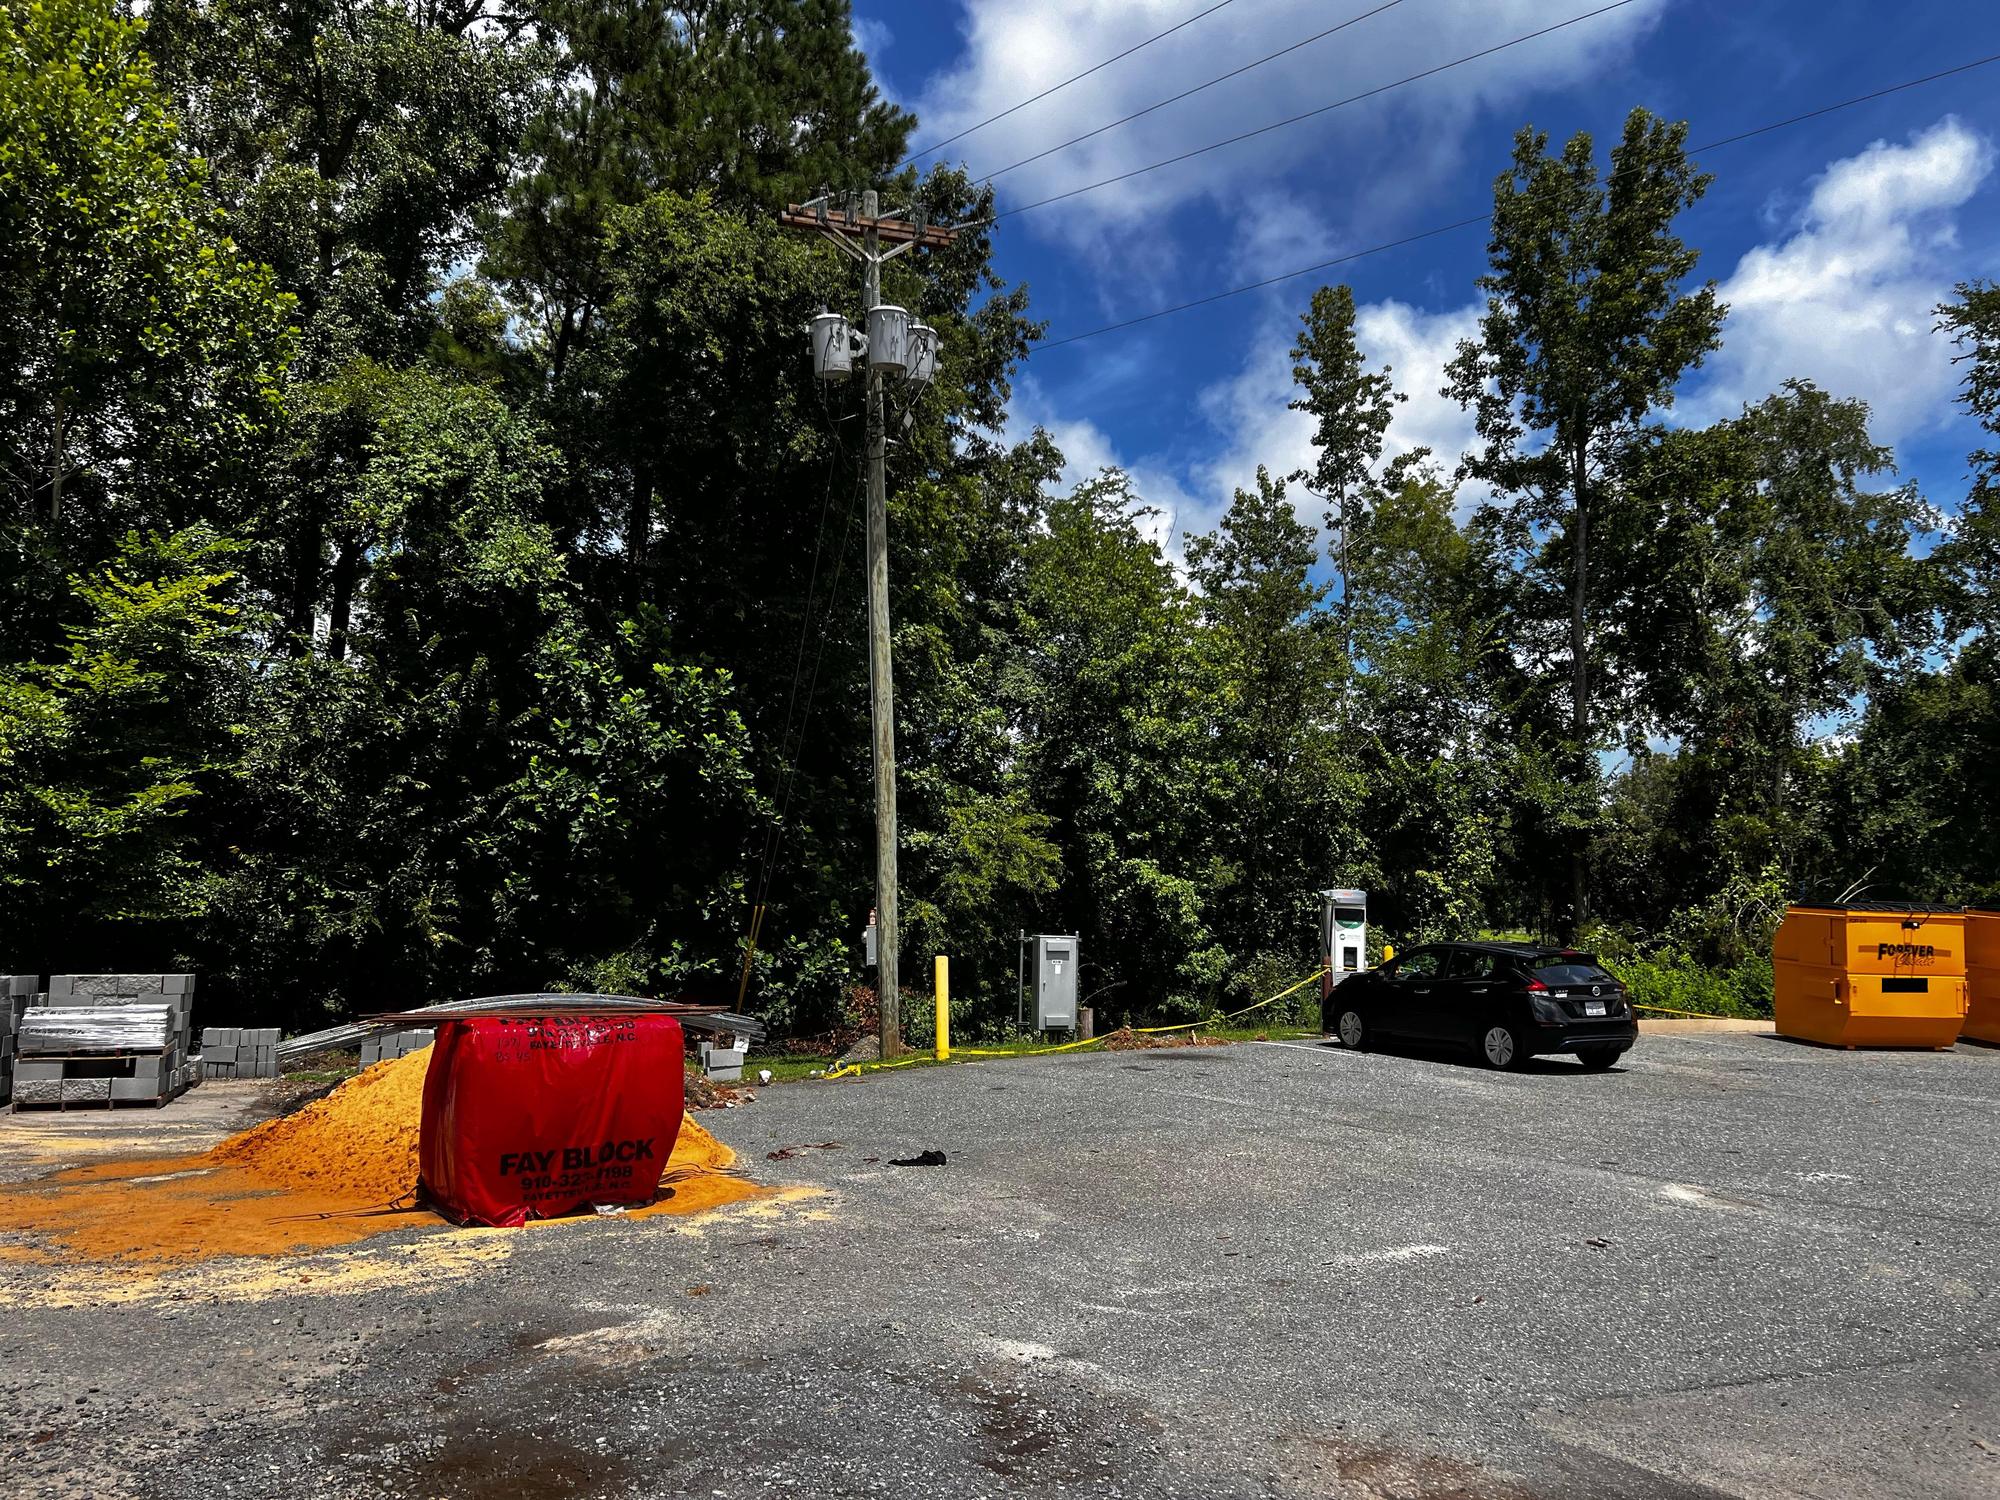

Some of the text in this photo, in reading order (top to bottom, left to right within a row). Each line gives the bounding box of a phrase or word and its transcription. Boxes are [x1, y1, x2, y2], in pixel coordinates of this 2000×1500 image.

[1878, 943, 1934, 960] FOREVER
[499, 1137, 655, 1176] FAY BLOCK
